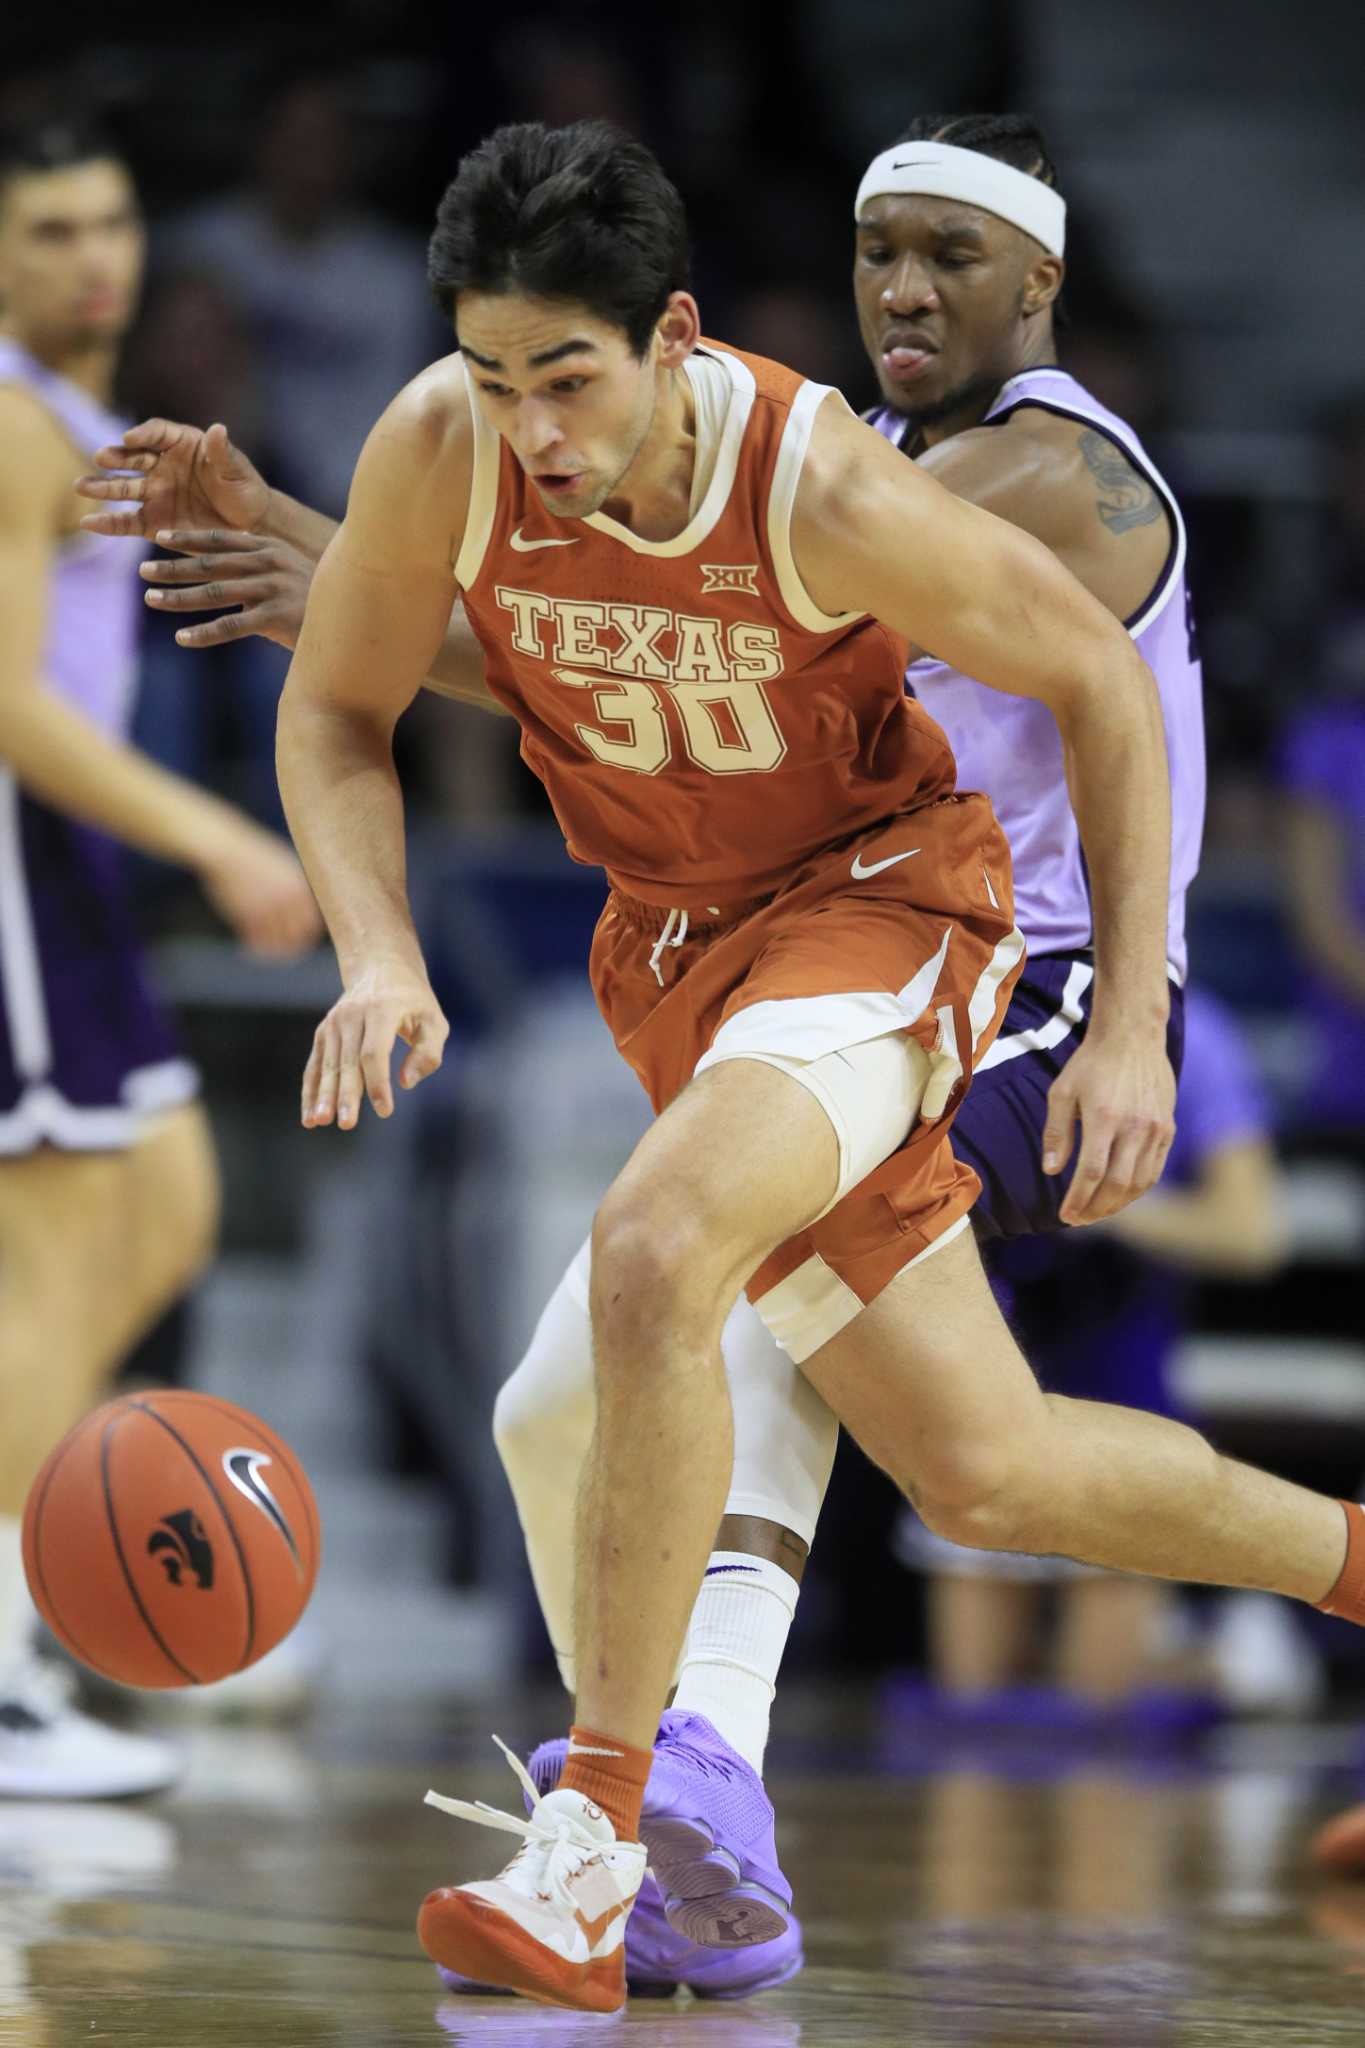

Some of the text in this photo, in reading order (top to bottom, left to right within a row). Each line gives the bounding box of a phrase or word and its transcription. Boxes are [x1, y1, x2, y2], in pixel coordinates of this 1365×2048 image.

[701, 565, 760, 596] XII
[495, 586, 784, 683] TEXAS
[551, 667, 788, 776] 30
